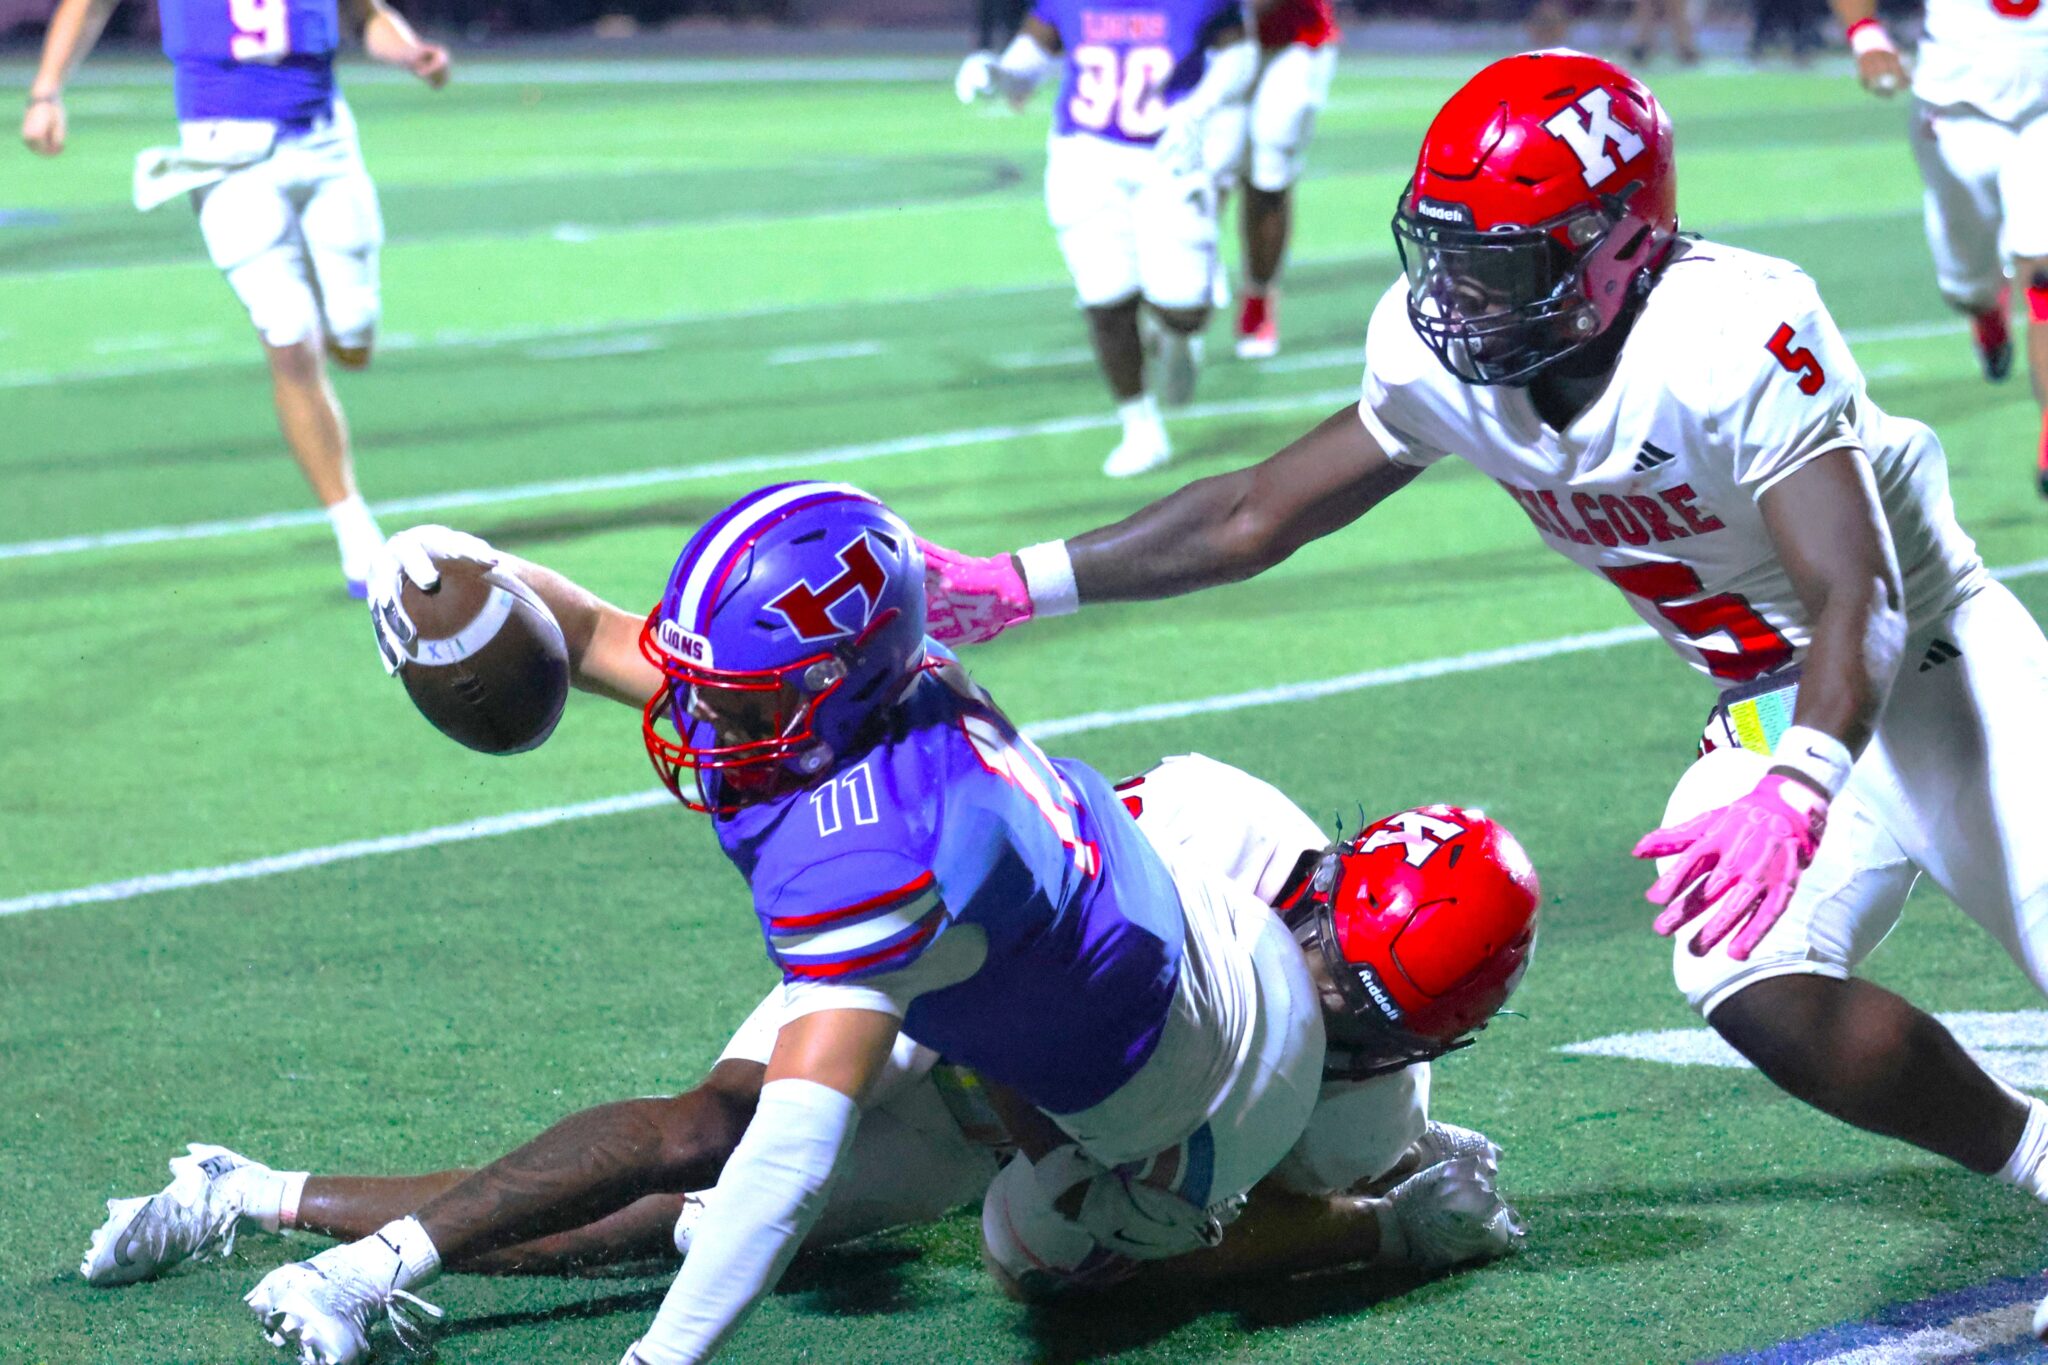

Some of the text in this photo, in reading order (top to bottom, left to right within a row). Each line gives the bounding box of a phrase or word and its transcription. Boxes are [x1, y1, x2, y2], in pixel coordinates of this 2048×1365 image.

[1070, 45, 1174, 134] 30
[1543, 85, 1646, 189] K
[1765, 322, 1826, 397] 5
[762, 528, 889, 643] H
[1597, 560, 1795, 682] 5
[662, 623, 704, 661] LIONS
[809, 762, 879, 838] 11
[1359, 811, 1467, 870] K
[1358, 969, 1399, 1021] Riddell
